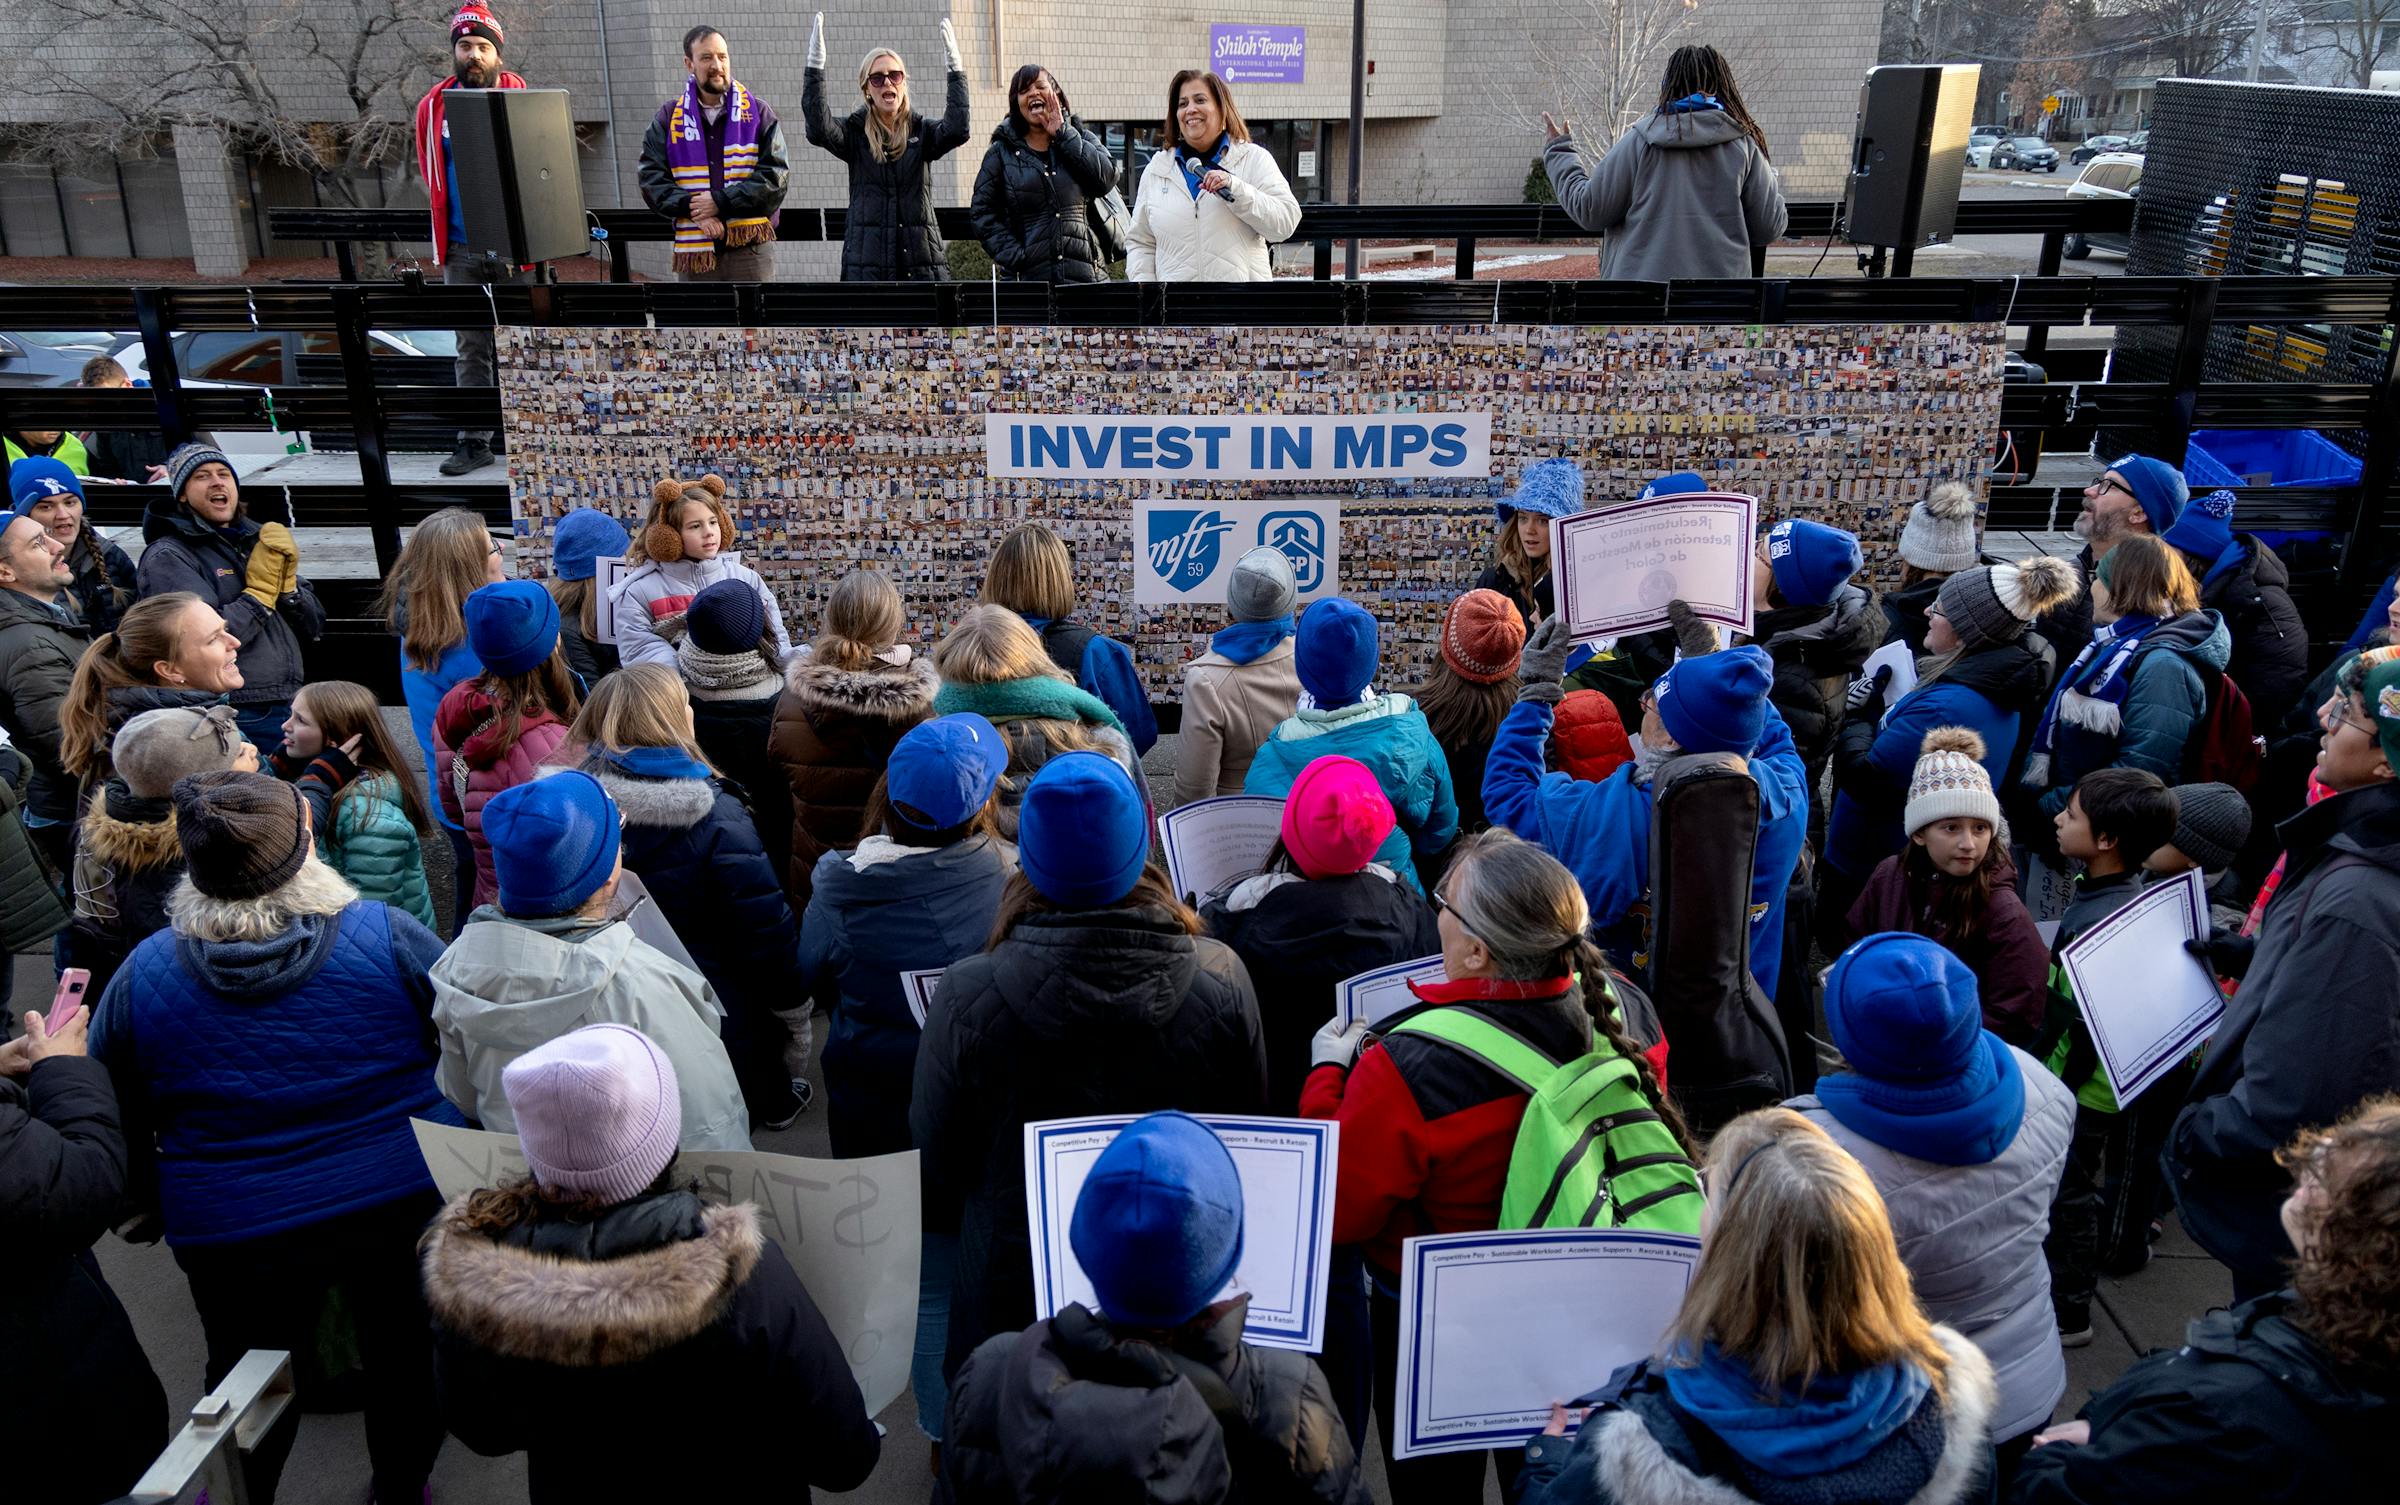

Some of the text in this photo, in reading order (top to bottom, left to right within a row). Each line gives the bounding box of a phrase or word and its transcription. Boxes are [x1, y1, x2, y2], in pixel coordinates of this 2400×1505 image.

[1215, 35, 1303, 61] Shiloh Temple
[1010, 423, 1467, 470] INVEST IN MPS
[1187, 563, 1204, 577] 59
[1290, 556, 1308, 572] SP
[1432, 1252, 1471, 1262] Competitive
[1472, 1252, 1485, 1260] Pay
[1530, 1247, 1562, 1255] Workload
[1603, 1246, 1632, 1254] Supports
[1424, 1421, 1463, 1432] Competitive
[1464, 1420, 1477, 1428] Pay
[1483, 1416, 1520, 1426] Sustainable
